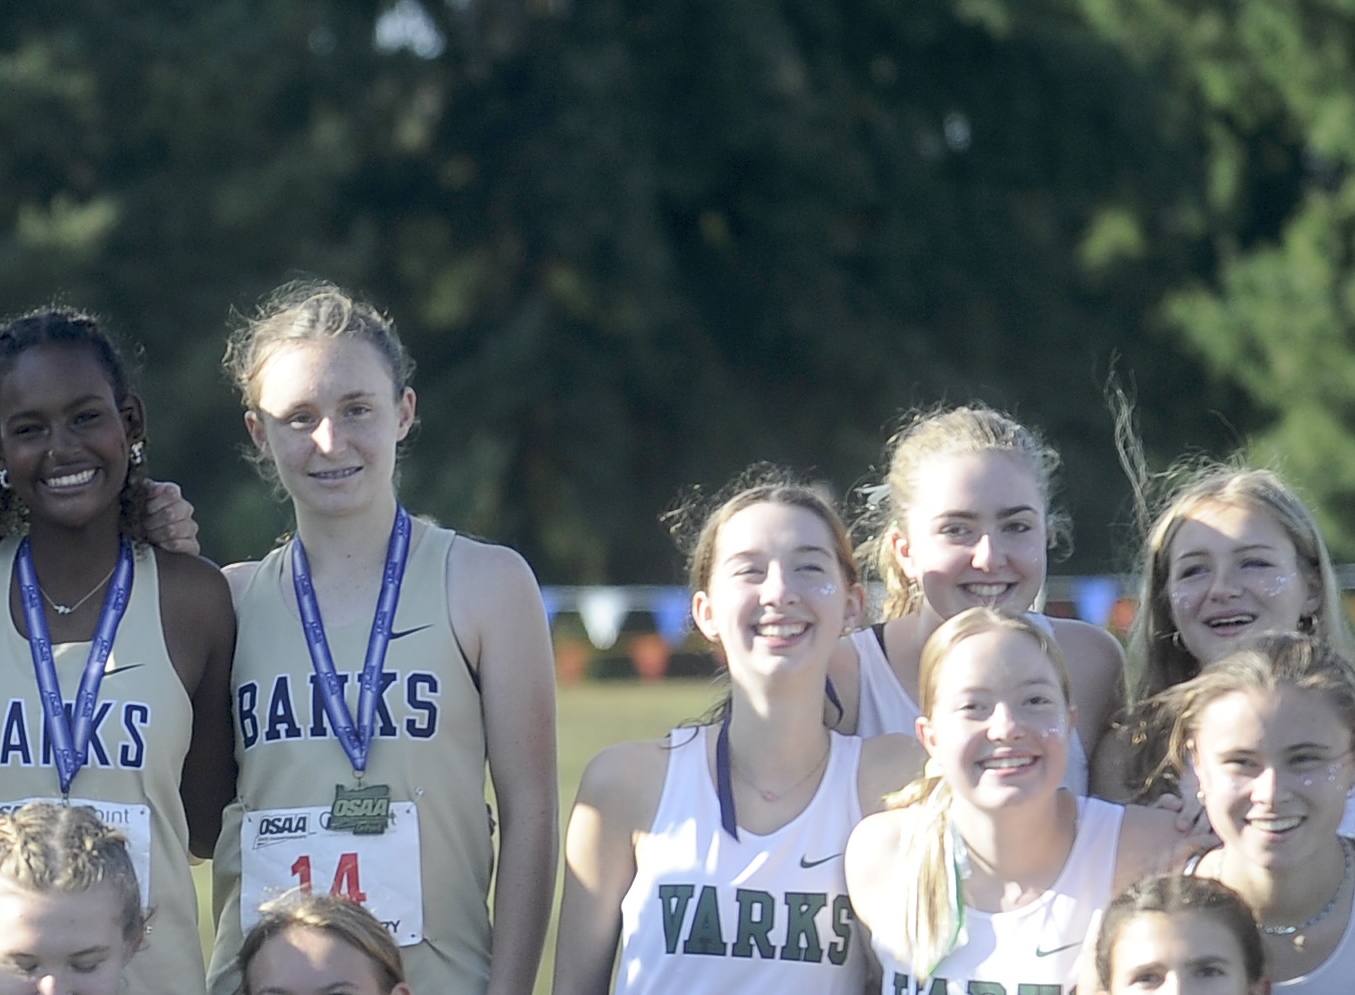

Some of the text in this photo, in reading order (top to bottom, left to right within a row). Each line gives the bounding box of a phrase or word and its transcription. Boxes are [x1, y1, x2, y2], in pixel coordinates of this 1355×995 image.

[239, 672, 438, 749] BANKS
[99, 808, 130, 824] oint
[260, 816, 307, 835] OSAA
[333, 798, 390, 817] OSAA
[291, 853, 367, 906] 14
[658, 884, 854, 966] VARKS
